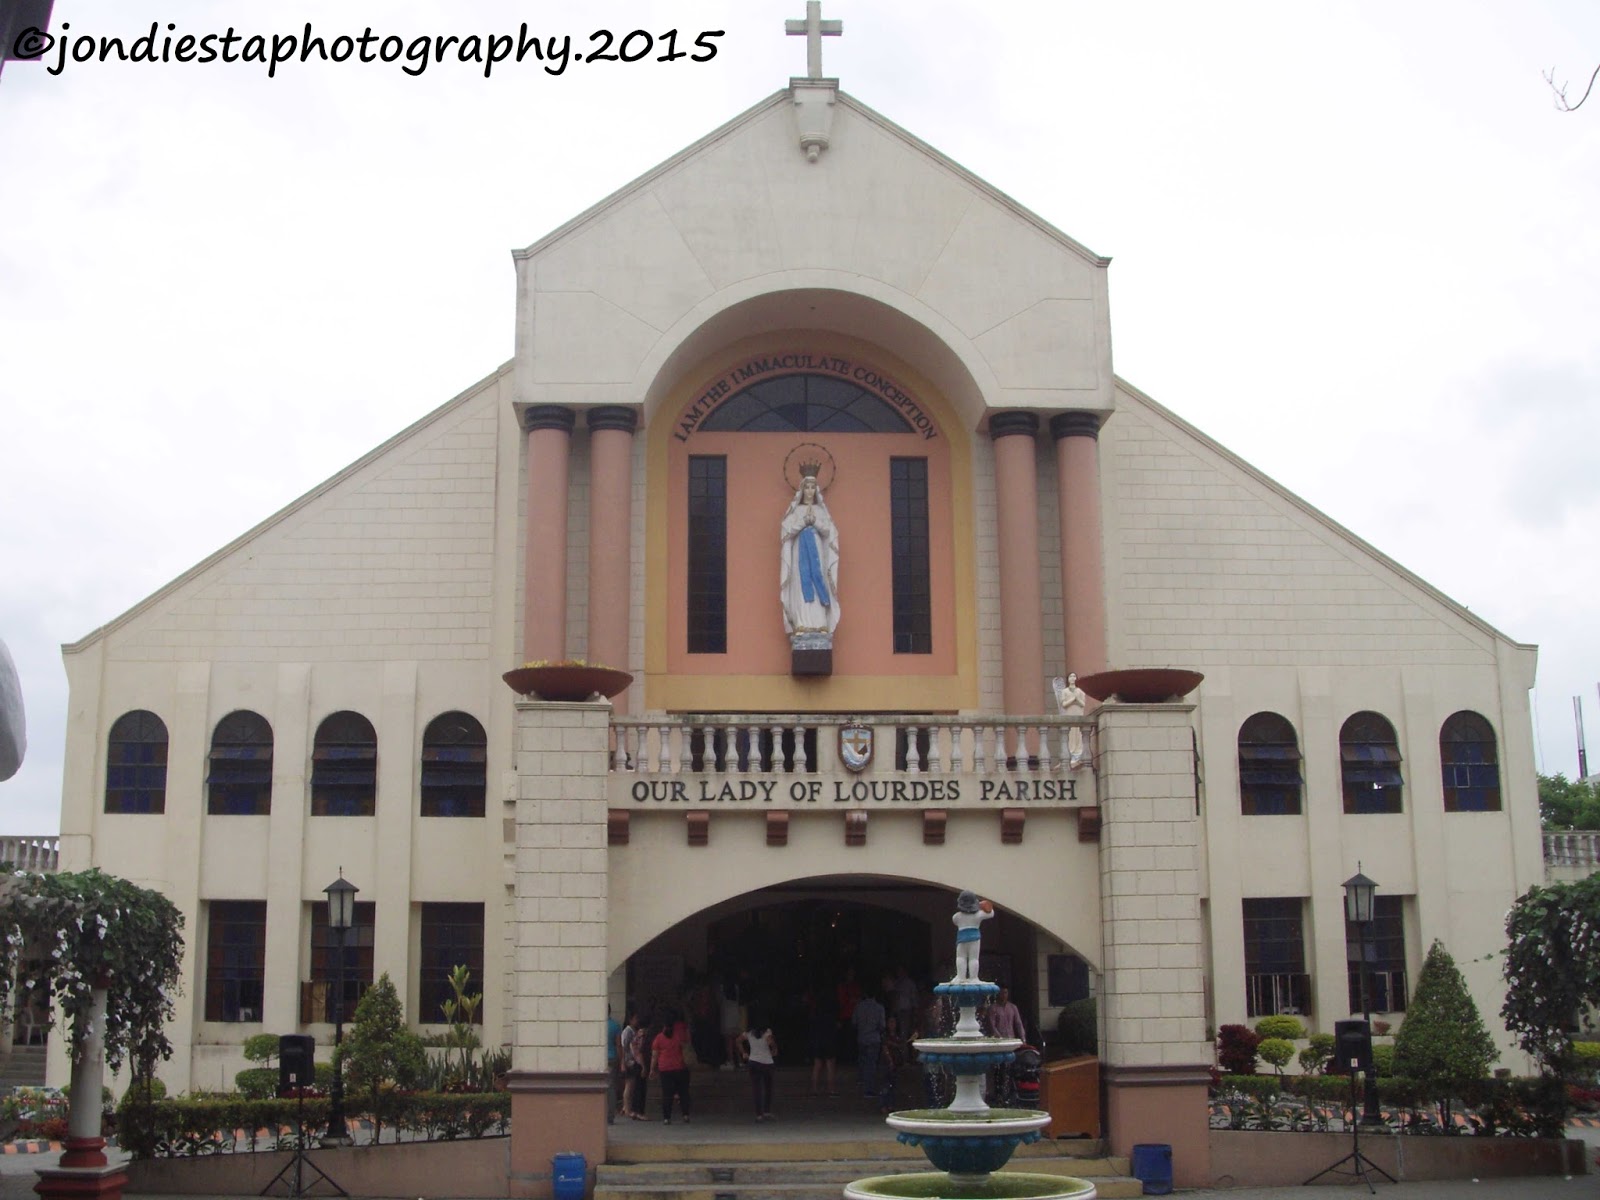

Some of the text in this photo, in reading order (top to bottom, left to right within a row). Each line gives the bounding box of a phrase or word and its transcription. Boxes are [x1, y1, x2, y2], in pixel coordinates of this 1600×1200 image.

[680, 405, 704, 434] AM
[698, 379, 731, 409] THE
[730, 354, 849, 384] IMMACULATE
[854, 367, 938, 440] CONCEPTION
[632, 780, 1078, 803] OUR LADY OF LOURDES PARISH
